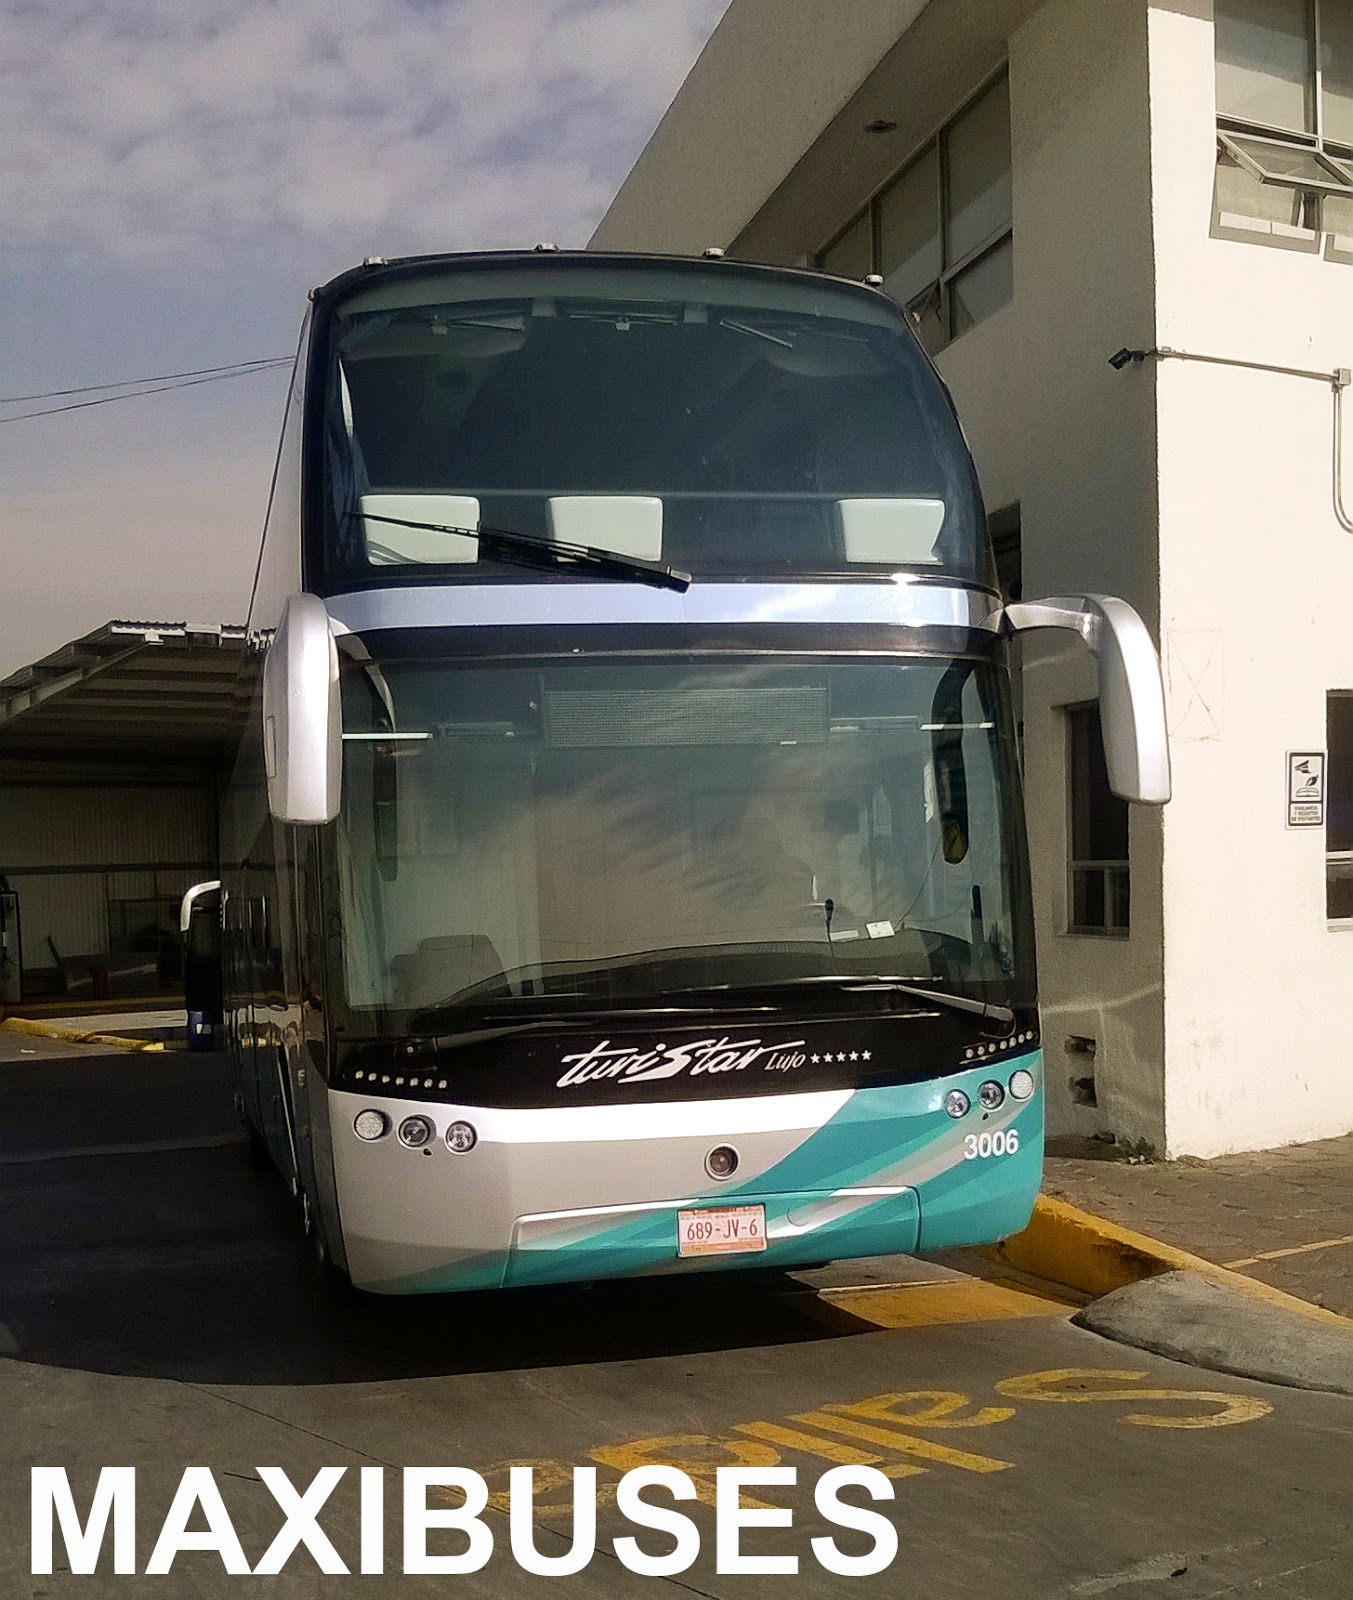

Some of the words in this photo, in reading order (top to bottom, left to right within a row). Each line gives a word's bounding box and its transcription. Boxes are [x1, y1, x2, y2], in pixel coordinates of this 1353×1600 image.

[764, 1051, 806, 1073] Lujo
[963, 1128, 1019, 1160] 3006
[687, 1219, 758, 1240] 689-JV-6
